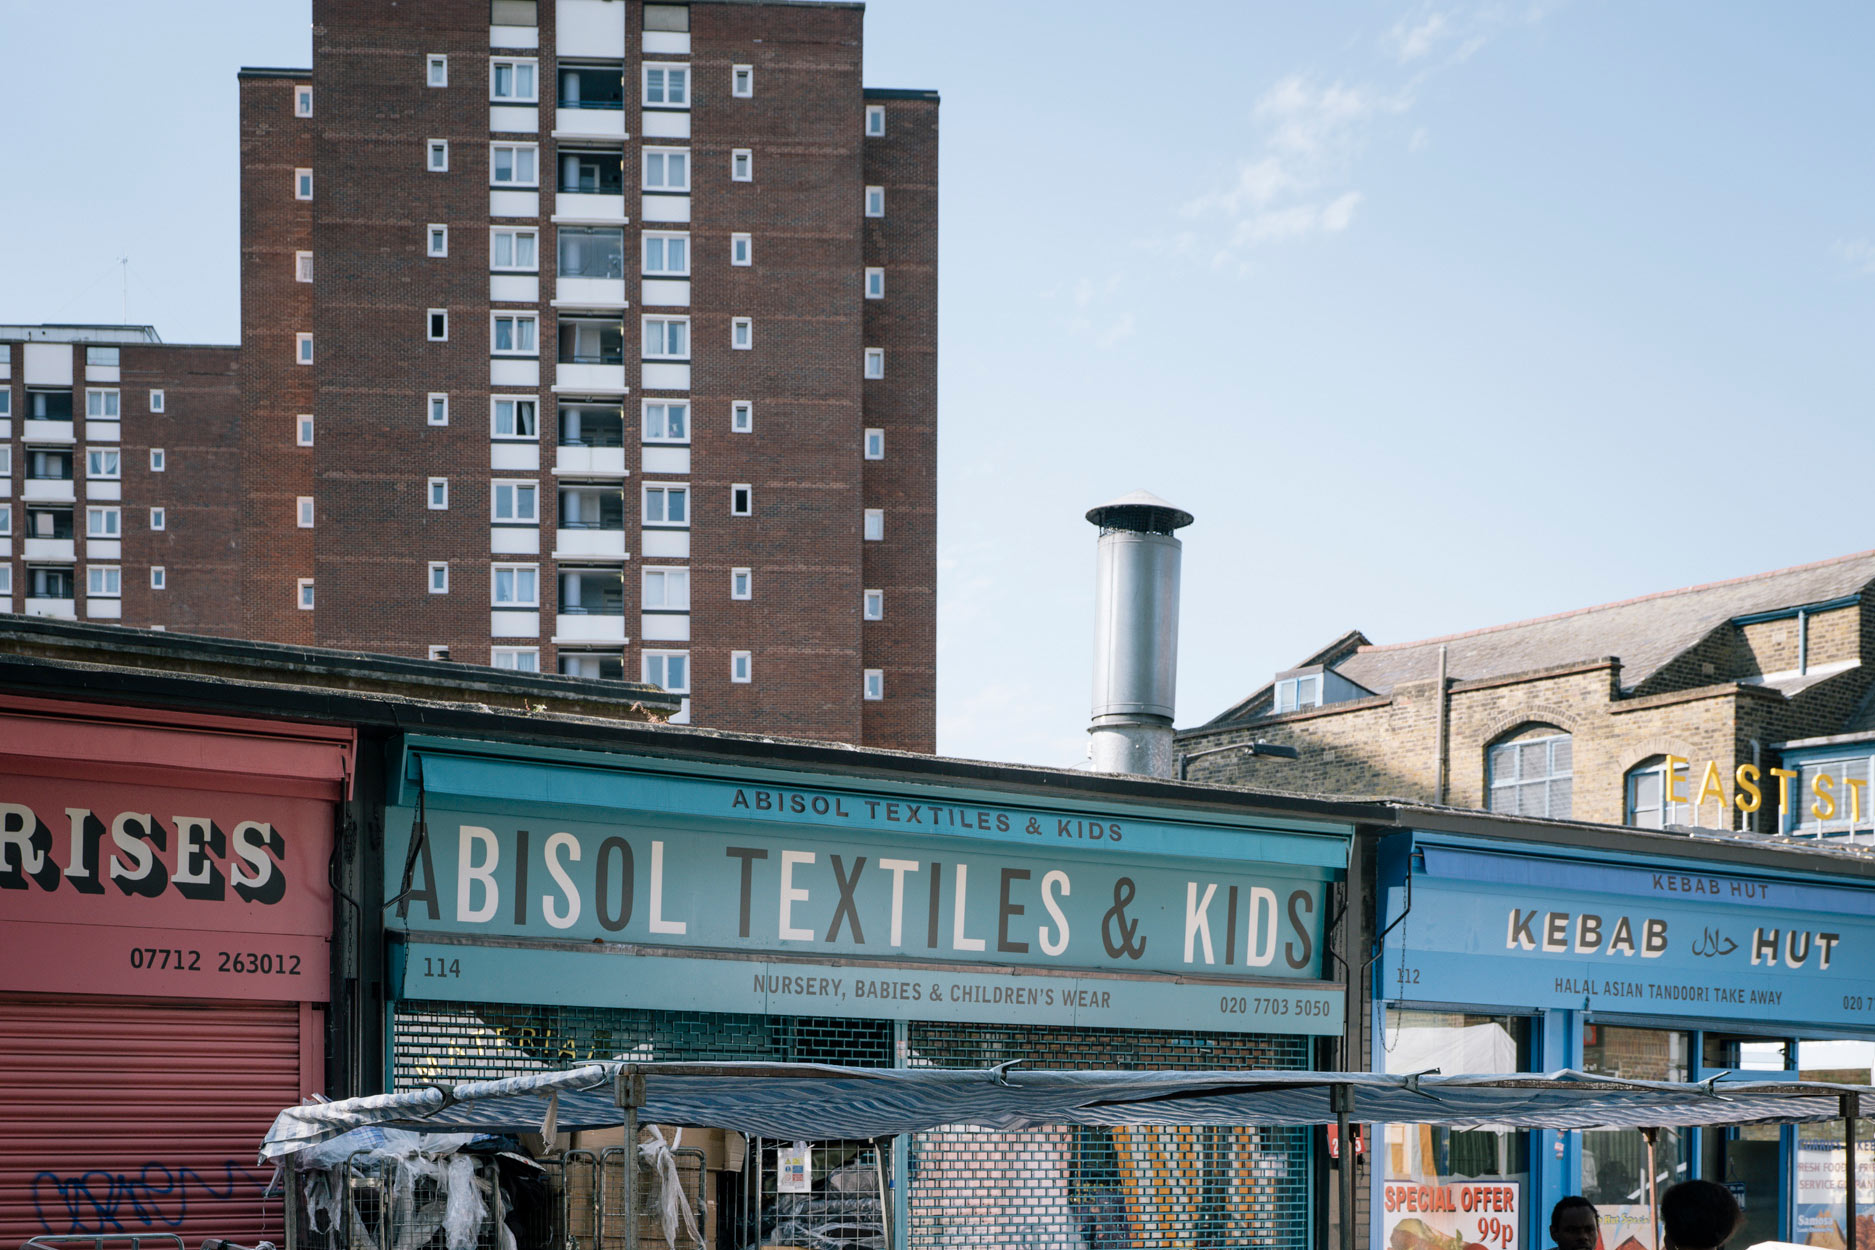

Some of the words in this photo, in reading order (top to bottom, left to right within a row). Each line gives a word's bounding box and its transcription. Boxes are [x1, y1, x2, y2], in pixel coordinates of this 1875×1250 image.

[1665, 754, 1798, 816] EAST
[732, 788, 849, 818] ABISOL
[864, 800, 1010, 833] TEXTILES
[1025, 816, 1042, 836] &
[1057, 818, 1123, 843] KIDS
[0, 803, 286, 904] RISES
[395, 821, 687, 935] ABISOL
[726, 846, 1071, 957] TEXTILES
[1101, 877, 1147, 960] &
[1184, 881, 1313, 970] KIDS
[1653, 874, 1721, 895] KEBAB
[1730, 882, 1769, 900] HUT
[1506, 908, 1668, 959] KEBAB
[1751, 927, 1840, 971] HUT
[131, 948, 200, 971] 07712
[218, 952, 301, 976] 263012
[424, 957, 461, 978] 114
[1396, 967, 1421, 985] 112
[753, 974, 847, 1000] NURSERY,
[855, 979, 922, 1001] BABIES
[929, 983, 943, 1002] &
[950, 984, 1054, 1006] CHILDREN'S
[1062, 989, 1111, 1009] WEAR
[1220, 996, 1247, 1015] 020
[1253, 997, 1290, 1016] 7703
[1294, 999, 1330, 1018] 5050
[1554, 977, 1598, 995] HALAL
[1603, 980, 1643, 998] ASIAN
[1648, 983, 1709, 1002] TANDOORI
[1714, 987, 1745, 1003] TAKE
[1750, 989, 1783, 1006] AWAY
[1843, 995, 1863, 1011] 020
[1384, 1185, 1456, 1213] SPECIAL
[1460, 1186, 1514, 1213] OFFER
[1477, 1216, 1515, 1250] 99p
